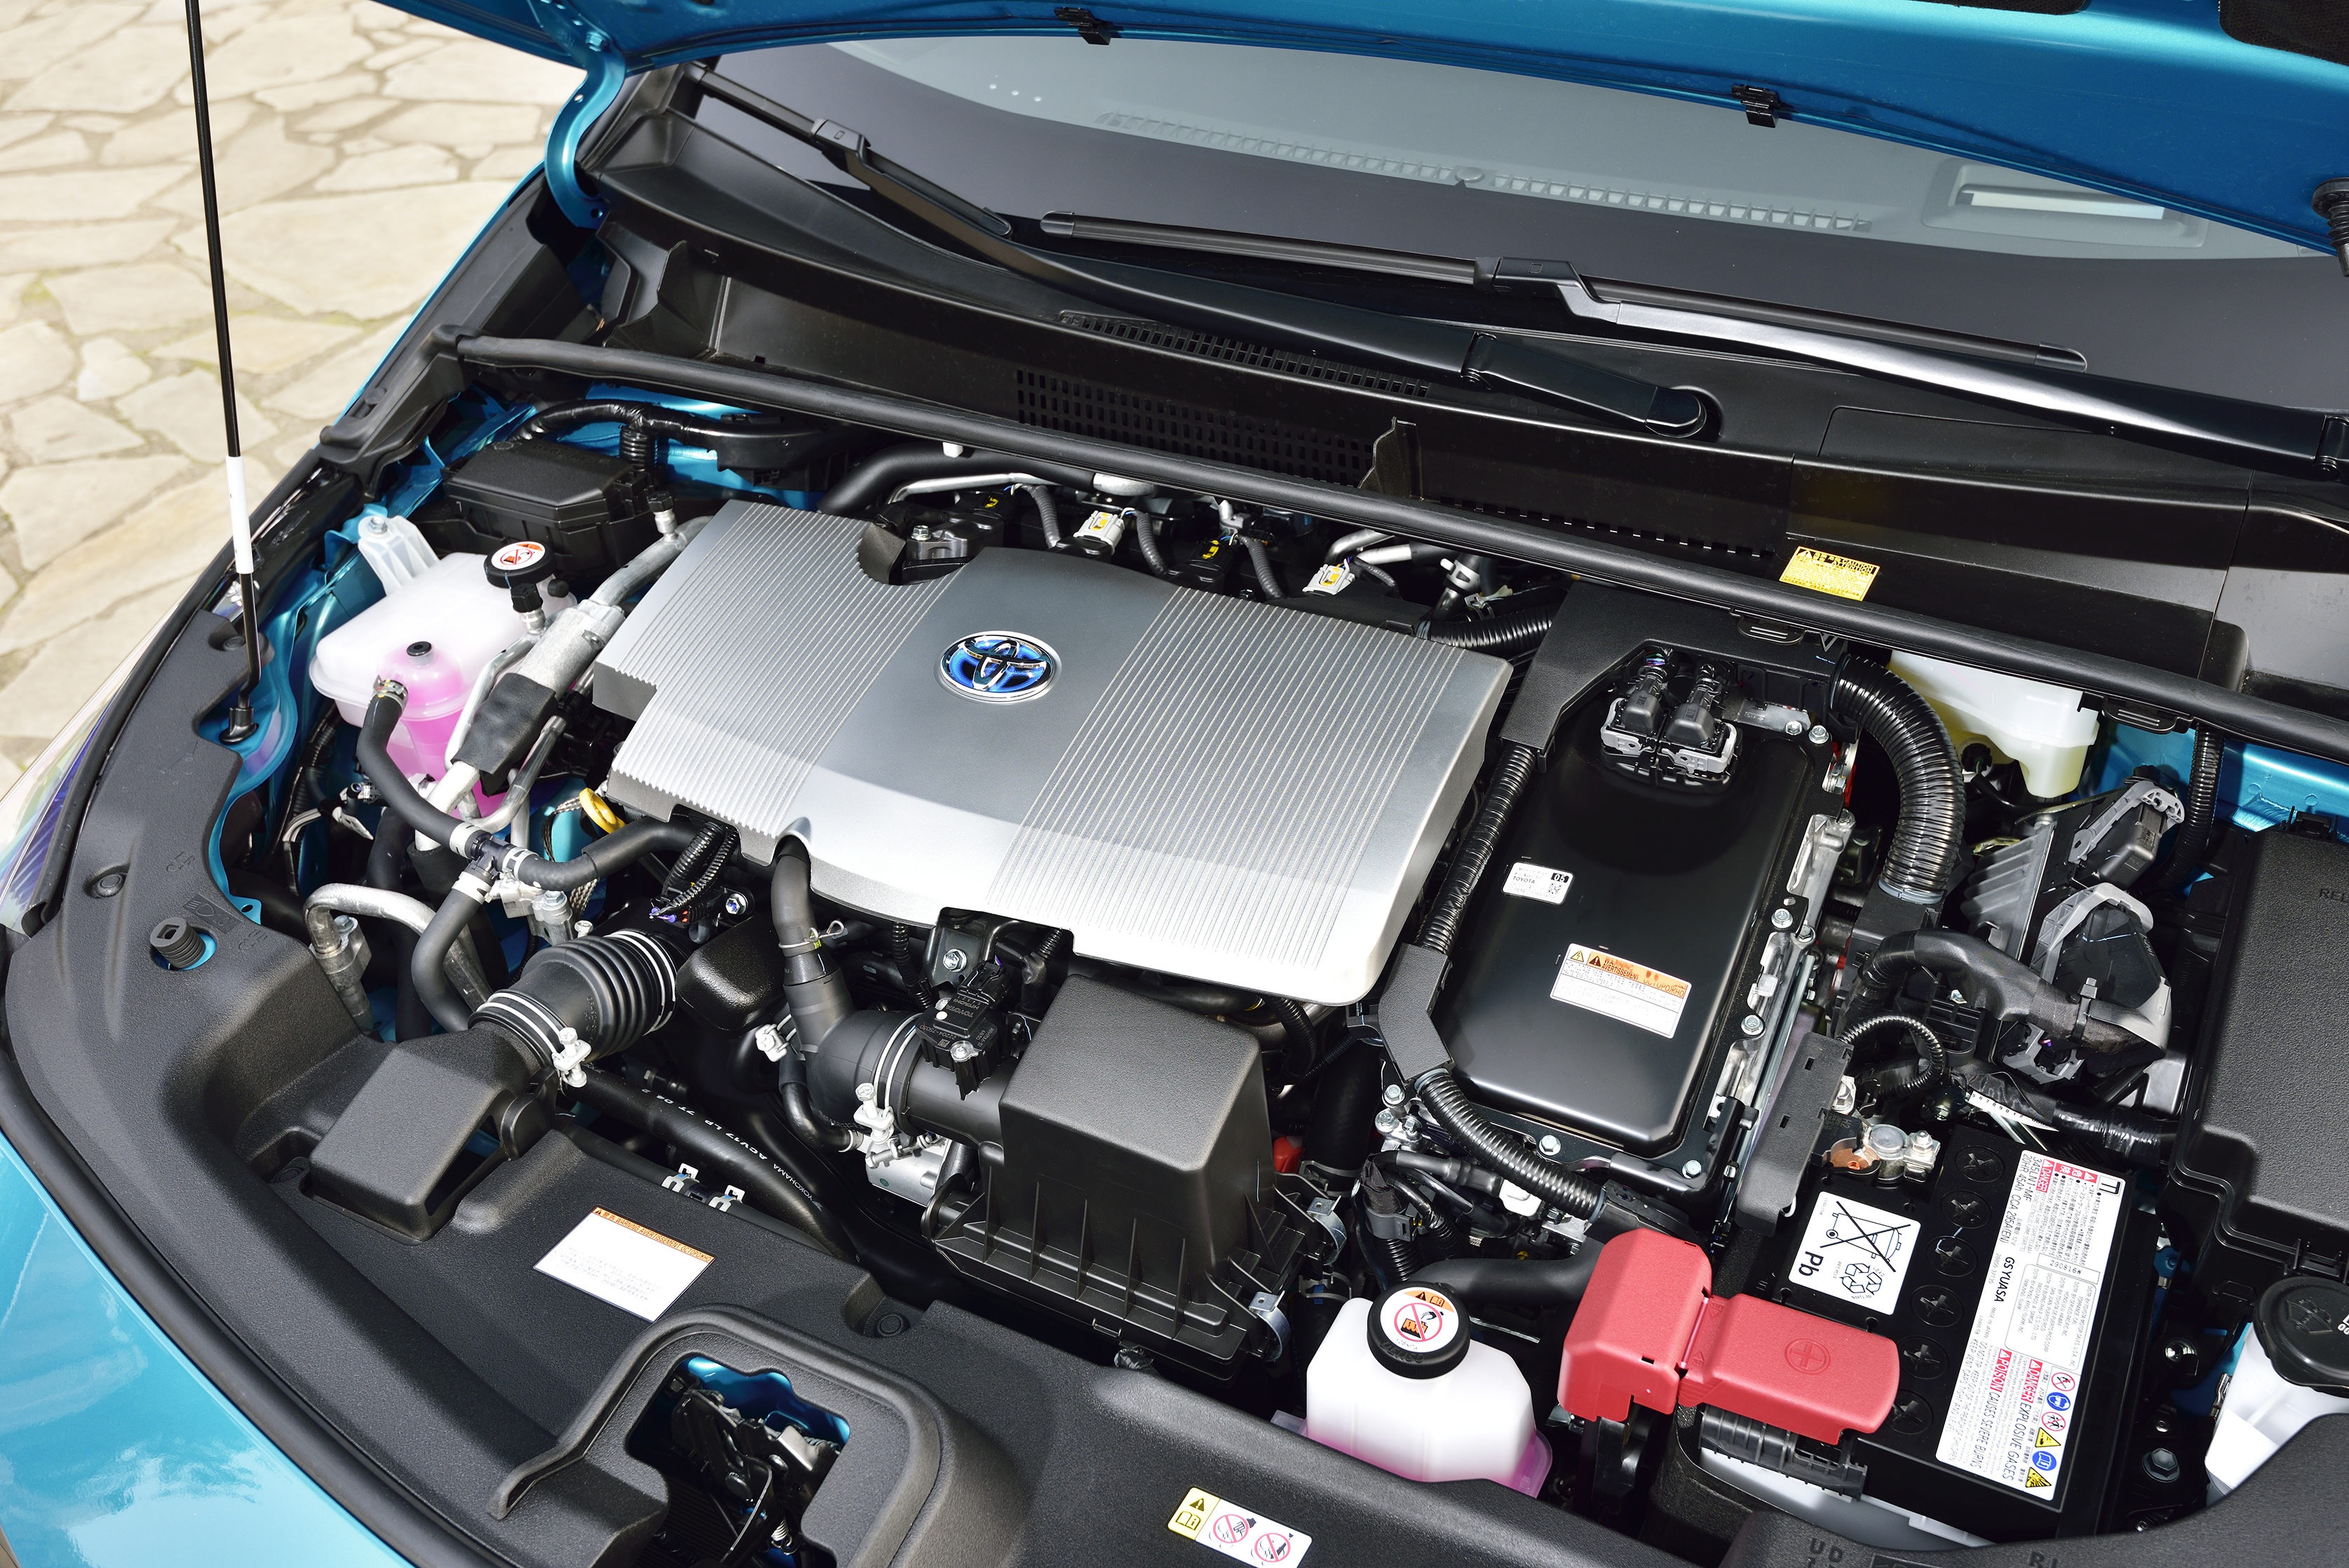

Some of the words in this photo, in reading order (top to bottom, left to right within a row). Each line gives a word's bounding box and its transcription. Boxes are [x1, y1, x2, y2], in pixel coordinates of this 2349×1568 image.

[1512, 875, 1536, 884] TOYOTA
[1553, 873, 1566, 881] 05
[1601, 962, 1639, 980] AVERTISSEMENT
[945, 1003, 974, 1018] TOYOTA
[952, 997, 980, 1010] HITACHI
[678, 1106, 696, 1116] 7T
[705, 1119, 722, 1130] LP
[1839, 1117, 1852, 1129] H2
[726, 1133, 768, 1160] ACV17
[2018, 1153, 2032, 1173] 20HR
[2059, 1165, 2083, 1178] 危険
[773, 1163, 813, 1201] YOKOHAMA
[2013, 1172, 2027, 1192] 45Ah
[2022, 1156, 2042, 1202] 345LN1-MF
[2036, 1167, 2052, 1192] DANGER
[2008, 1194, 2022, 1210] CCA
[614, 1217, 641, 1231] WARNING
[638, 1227, 682, 1249] AVERTISSEMENT
[1998, 1210, 2017, 1244] 295A(EN)
[1797, 1250, 1824, 1278] Pb
[2003, 1256, 2015, 1270] GS
[1993, 1269, 2012, 1304] YUASA
[1380, 1341, 1425, 1363] DENSO
[1968, 1338, 1979, 1353] KEEP
[1963, 1353, 1975, 1368] VENT
[1959, 1368, 1970, 1384] CAPS
[1990, 1358, 2009, 1391] POISON
[2021, 1367, 2040, 1402] DANGER
[1954, 1385, 1965, 1402] TIGHT
[1950, 1402, 1961, 1416] AND
[1982, 1391, 2001, 1419] CAUSES
[1975, 1417, 1993, 1445] SEVERE
[2009, 1402, 2031, 1450] EXPLOSIVE
[1969, 1444, 1987, 1470] BURNS
[2001, 1449, 2019, 1482] GASES
[1809, 1536, 1843, 1562] UD
